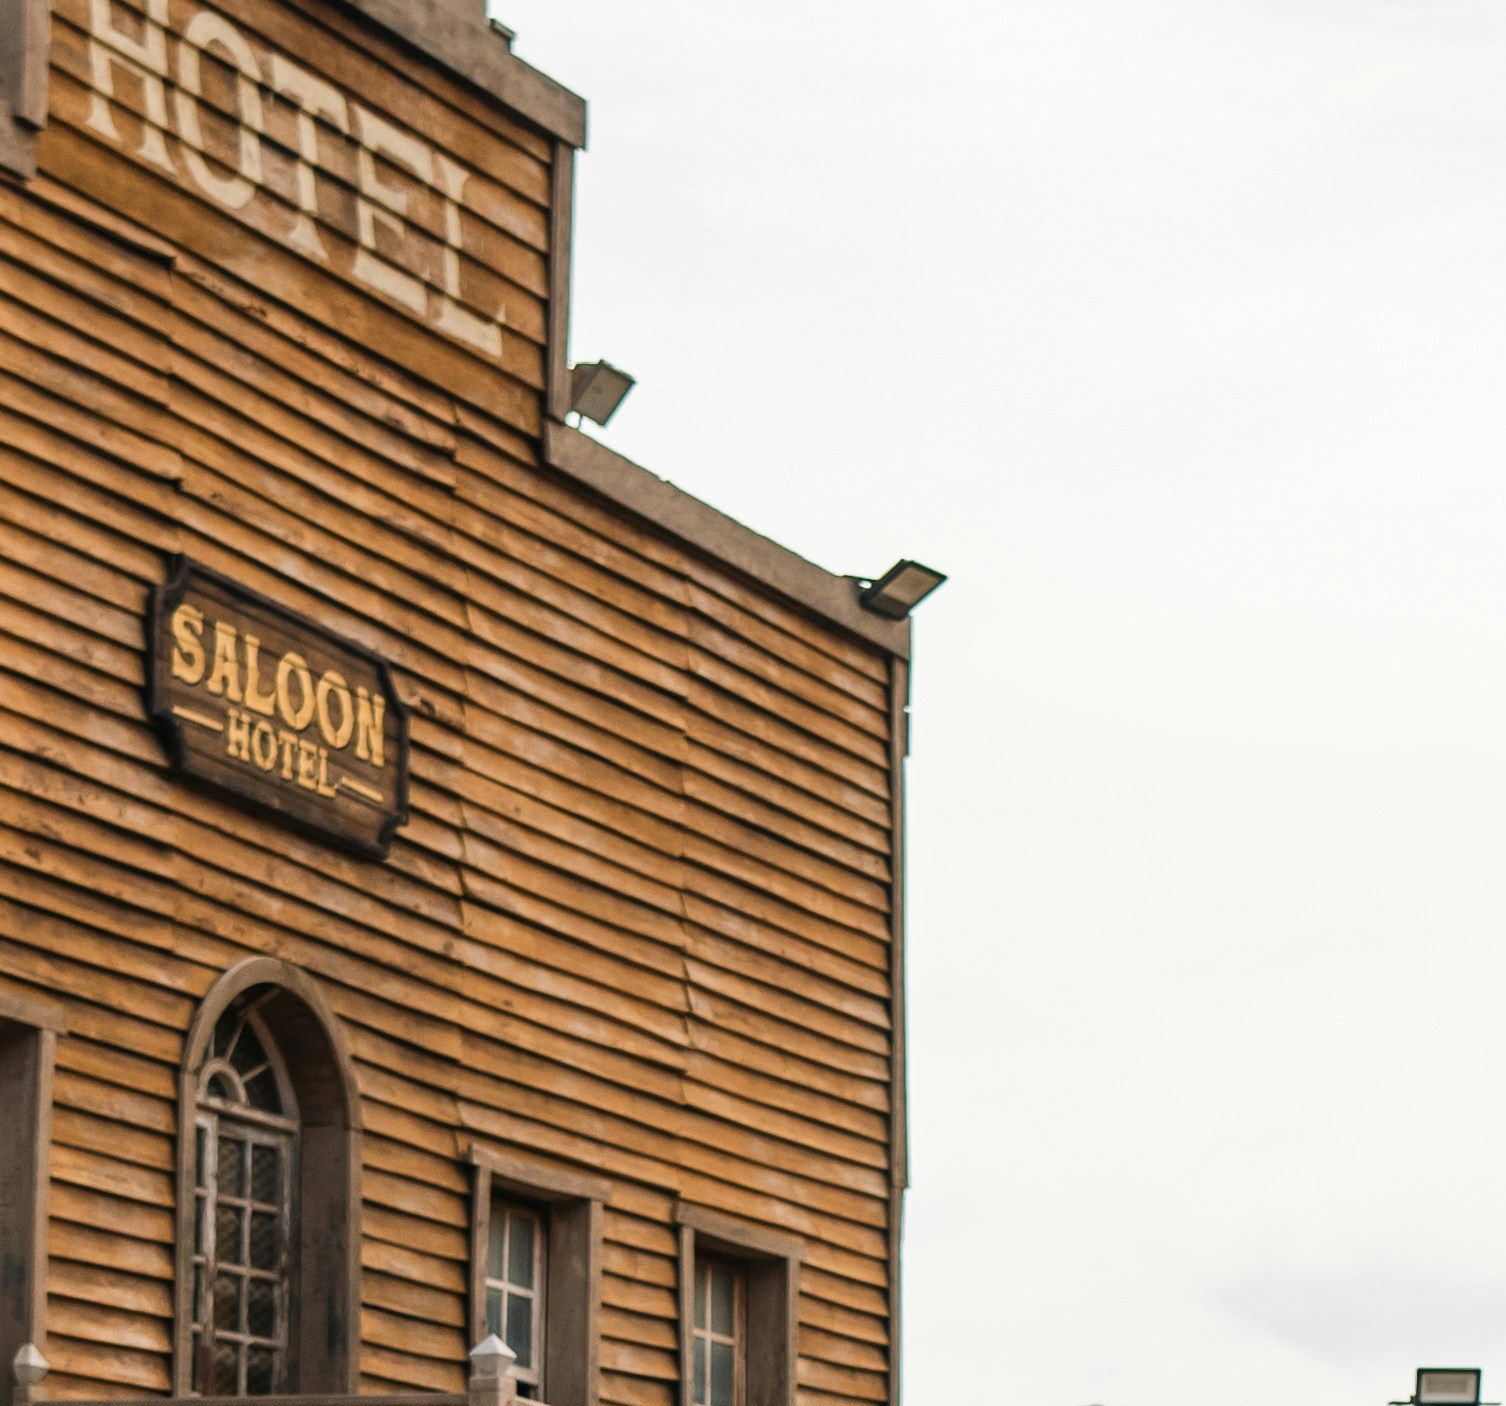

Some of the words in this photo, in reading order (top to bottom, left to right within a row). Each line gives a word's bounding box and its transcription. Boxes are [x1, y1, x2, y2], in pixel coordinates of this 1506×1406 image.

[87, 0, 505, 358] HOTEL
[170, 603, 386, 768] SALOON
[227, 707, 337, 798] HOTEL
